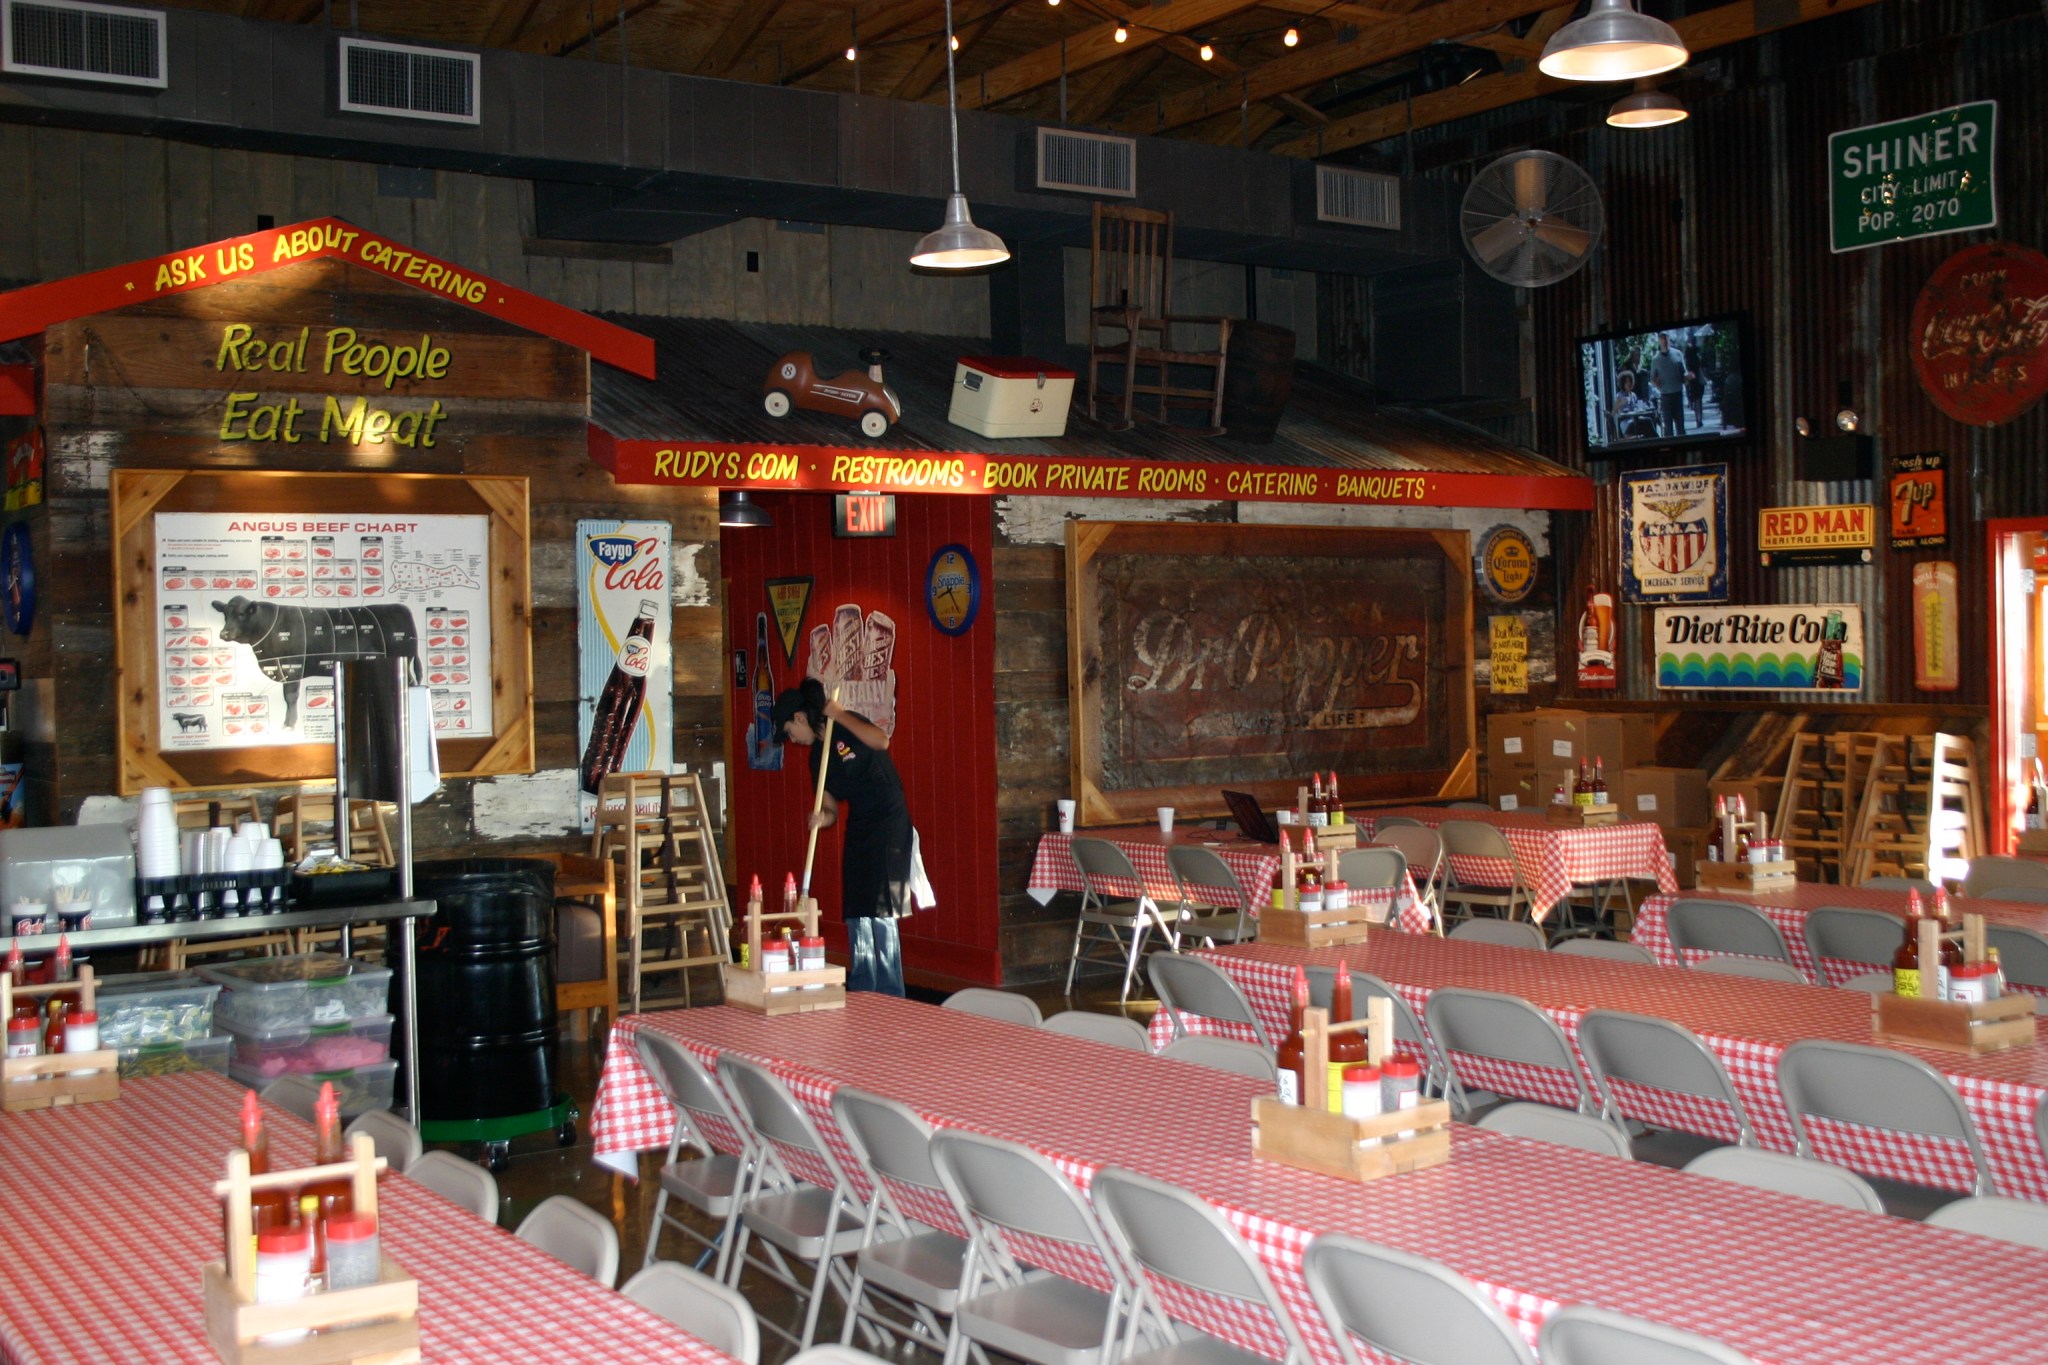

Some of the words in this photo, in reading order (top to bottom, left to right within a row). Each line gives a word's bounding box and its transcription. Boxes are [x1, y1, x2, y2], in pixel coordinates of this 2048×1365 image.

[1843, 121, 1977, 178] SHINER
[1861, 182, 1900, 205] CITY
[1914, 170, 1957, 195] LIMIT
[1912, 198, 1960, 223] 2070
[155, 258, 206, 292] ASK
[217, 243, 255, 274] US
[272, 226, 359, 263] ABOUT
[360, 241, 488, 304] CATERING
[216, 323, 309, 372] Real
[323, 327, 451, 389] People
[219, 392, 304, 443] Eat
[319, 395, 447, 448] Meat
[654, 449, 799, 482] RUDYS.COM
[831, 456, 964, 488] RESTROOMS
[984, 463, 1038, 489] BOOK
[1045, 464, 1130, 492] PRIVATE
[1138, 468, 1207, 493] ROOMS
[1226, 471, 1318, 497] CATERING
[1337, 474, 1425, 500] BANQUETS
[228, 521, 297, 532] ANGUS
[303, 522, 350, 533] BEEF
[354, 522, 418, 533] CHART
[846, 497, 886, 533] EXIT
[1765, 512, 1808, 537] RED
[1813, 508, 1864, 534] MAN
[598, 541, 632, 560] Faygo
[1765, 535, 1818, 545] HERITAGE
[1824, 534, 1865, 543] SERIES
[605, 537, 664, 591] Cola
[1494, 556, 1528, 571] Corona
[1666, 615, 1724, 644] Diet
[1725, 614, 1785, 643] Rite
